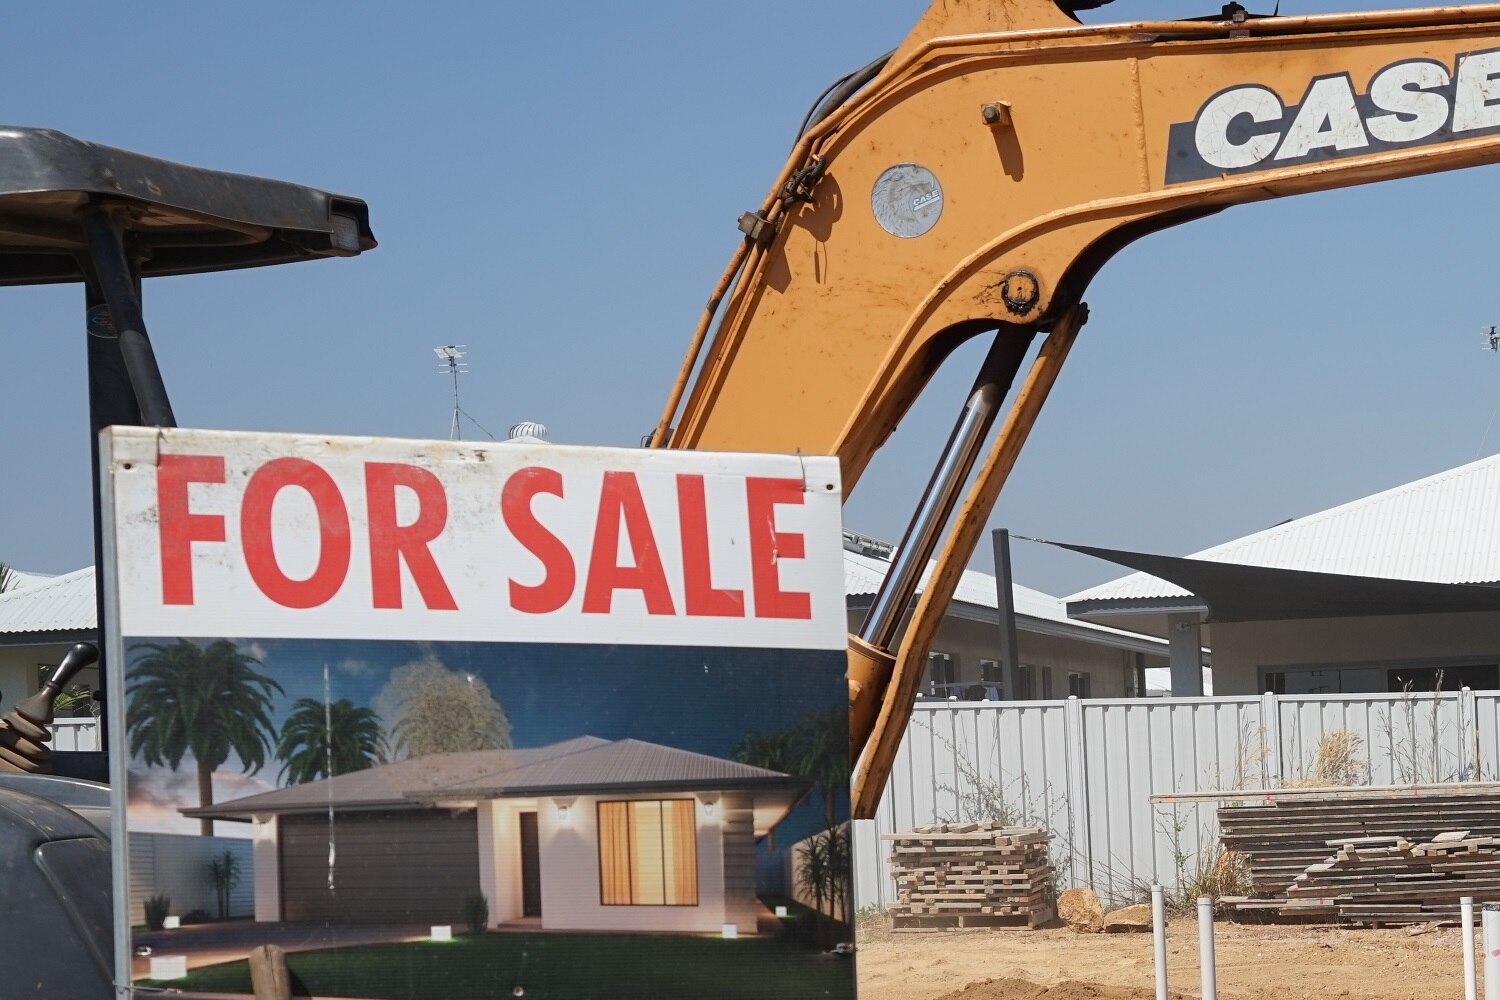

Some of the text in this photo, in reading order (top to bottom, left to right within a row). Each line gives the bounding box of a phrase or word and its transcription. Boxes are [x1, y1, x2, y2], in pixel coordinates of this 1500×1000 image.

[913, 190, 939, 206] CASE
[157, 454, 812, 620] FOR SALE
